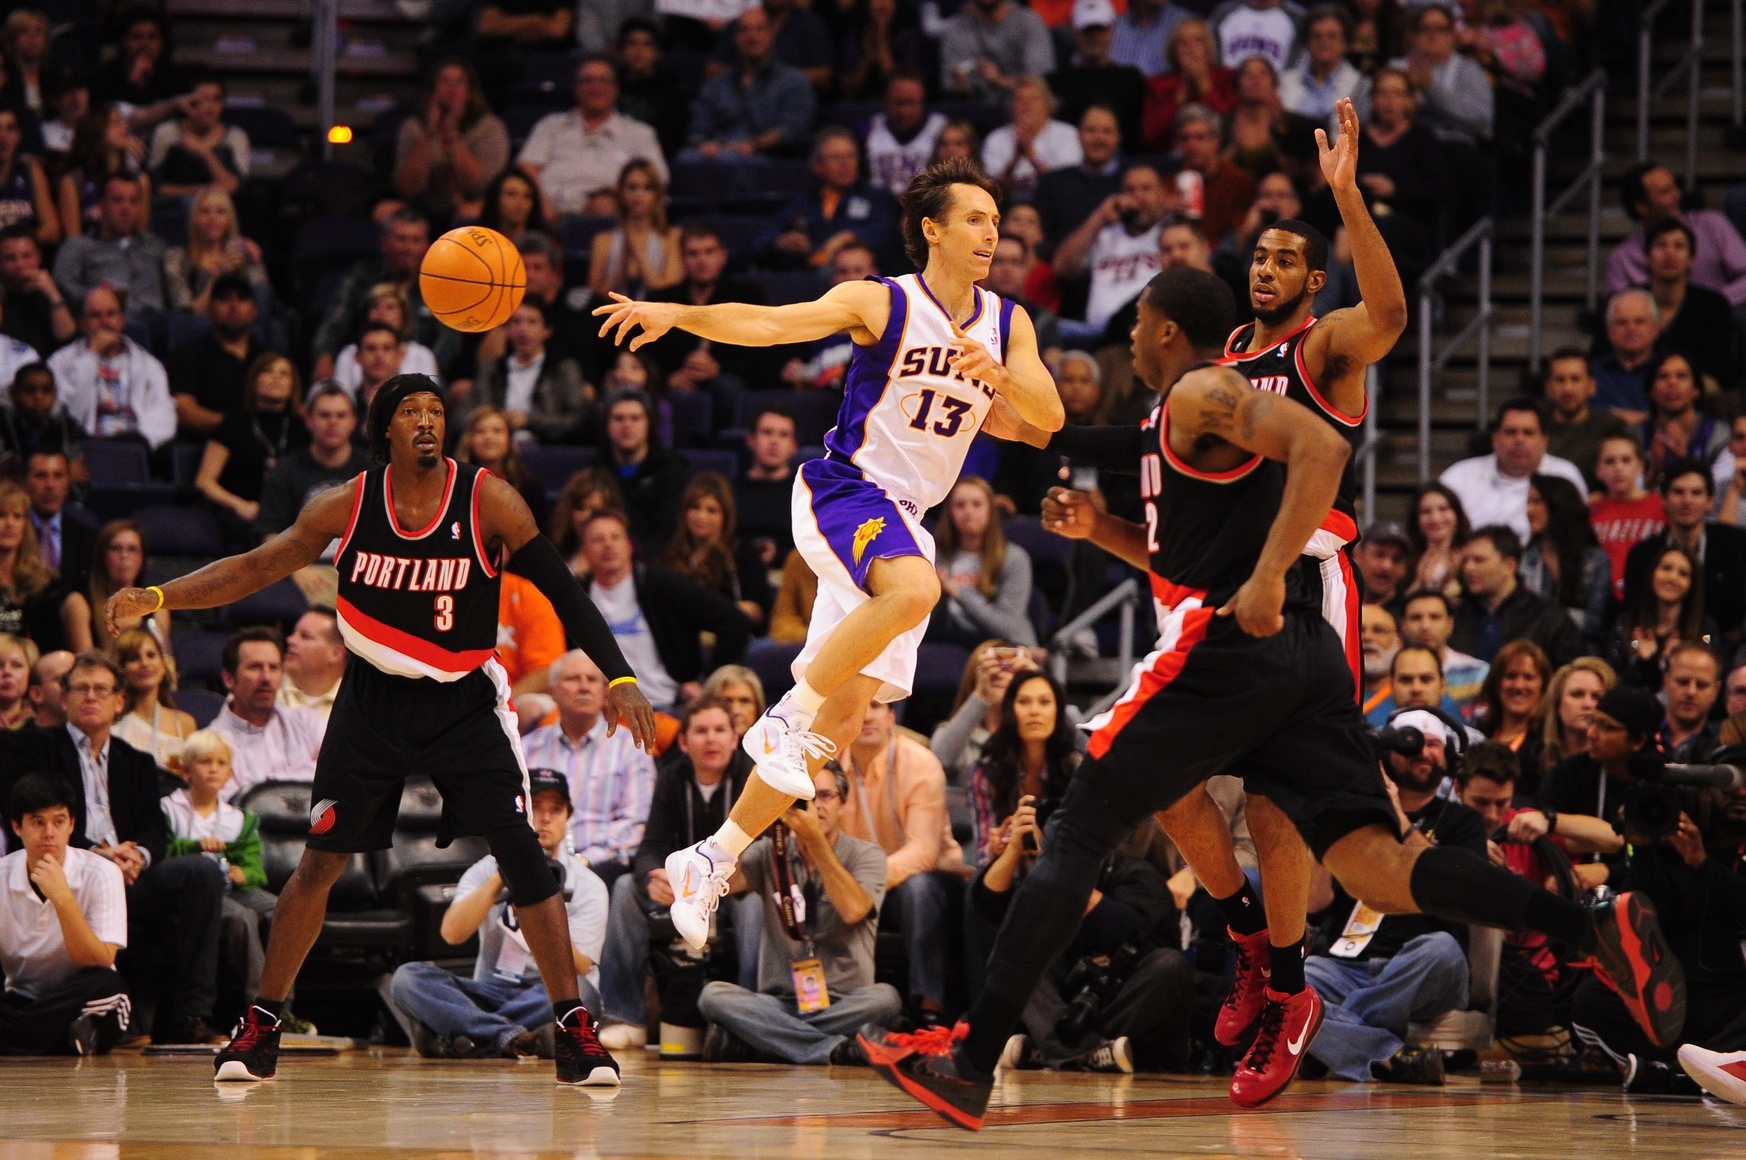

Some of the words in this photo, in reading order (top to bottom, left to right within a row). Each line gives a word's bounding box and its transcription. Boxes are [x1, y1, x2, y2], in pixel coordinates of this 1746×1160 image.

[898, 346, 996, 401] SU
[908, 387, 974, 439] 13
[351, 550, 472, 592] PORTLAND
[434, 594, 455, 632] 3
